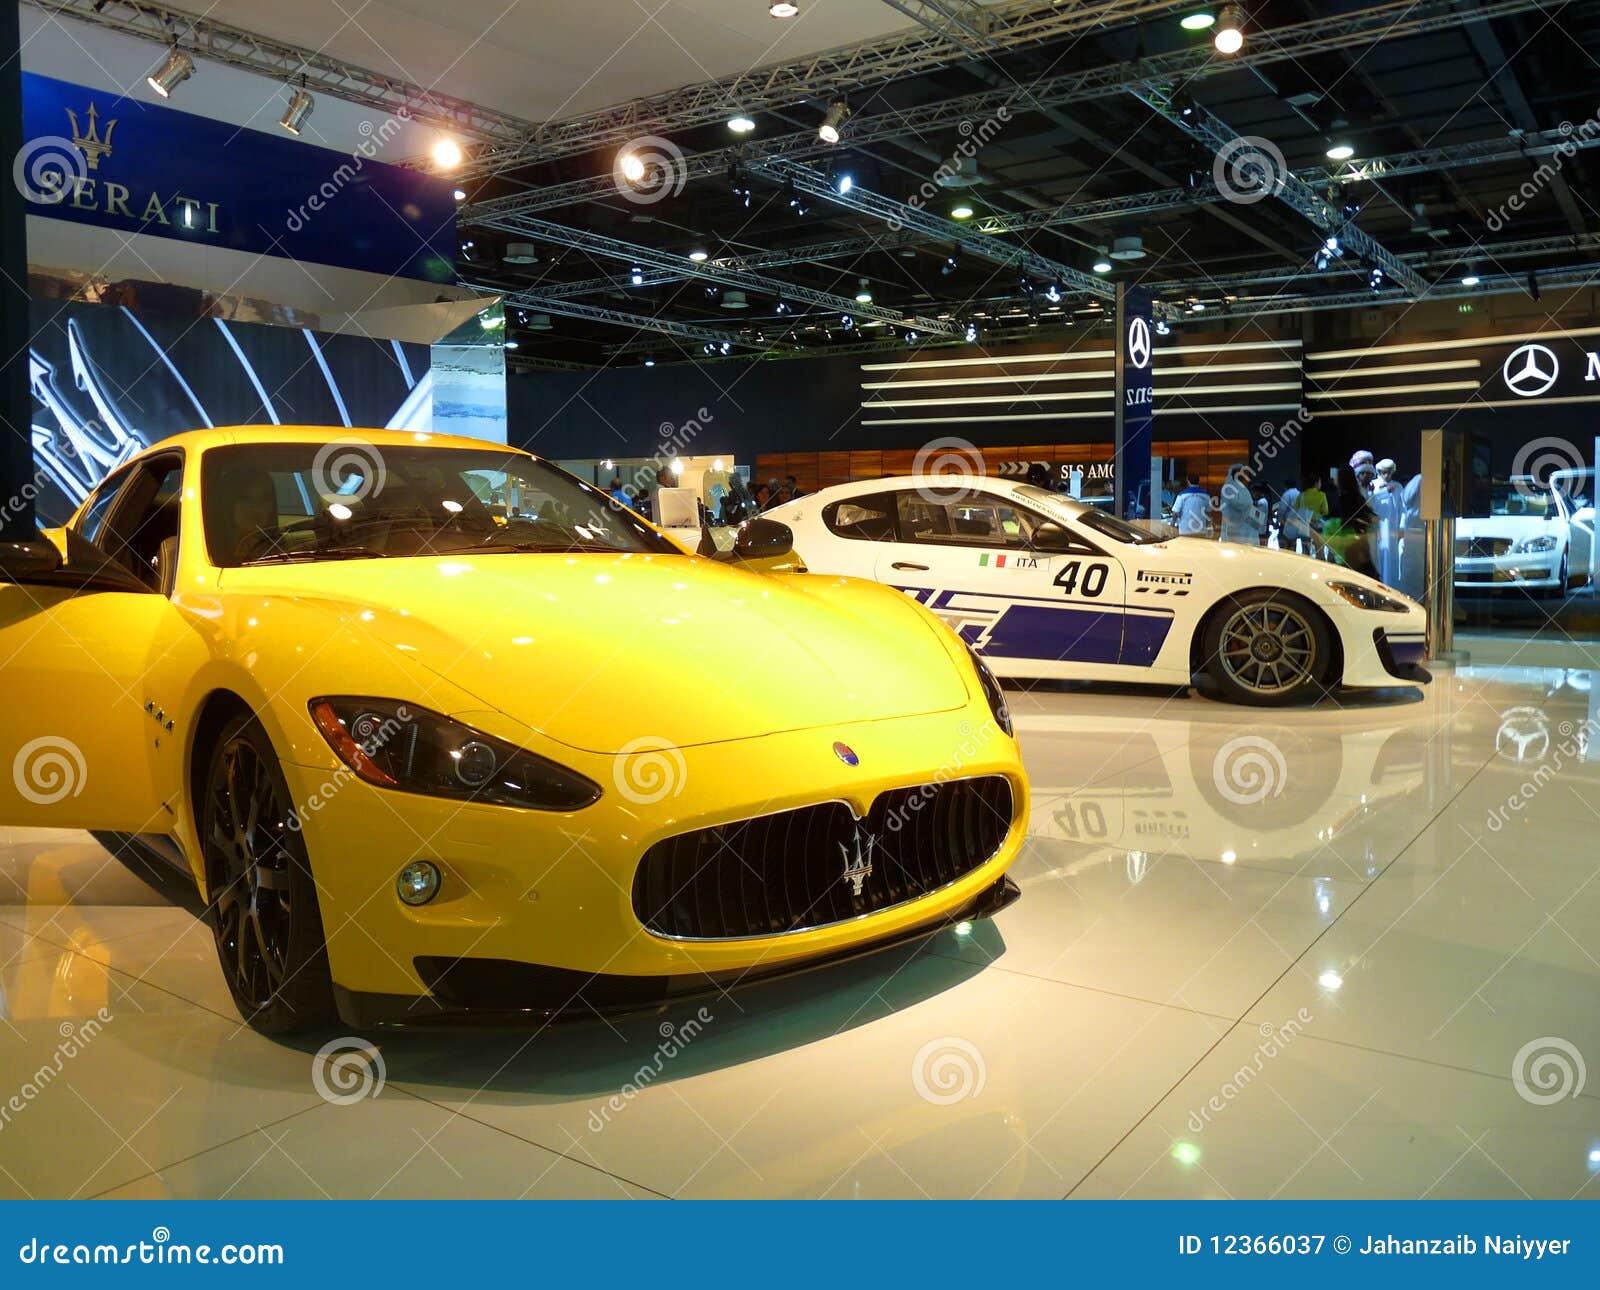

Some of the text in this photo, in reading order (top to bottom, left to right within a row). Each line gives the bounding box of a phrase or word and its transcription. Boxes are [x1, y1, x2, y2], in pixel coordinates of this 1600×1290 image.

[25, 170, 220, 233] SERATI
[1016, 557, 1037, 569] ITA
[1052, 560, 1109, 597] 40
[1137, 570, 1192, 585] PIRELLI
